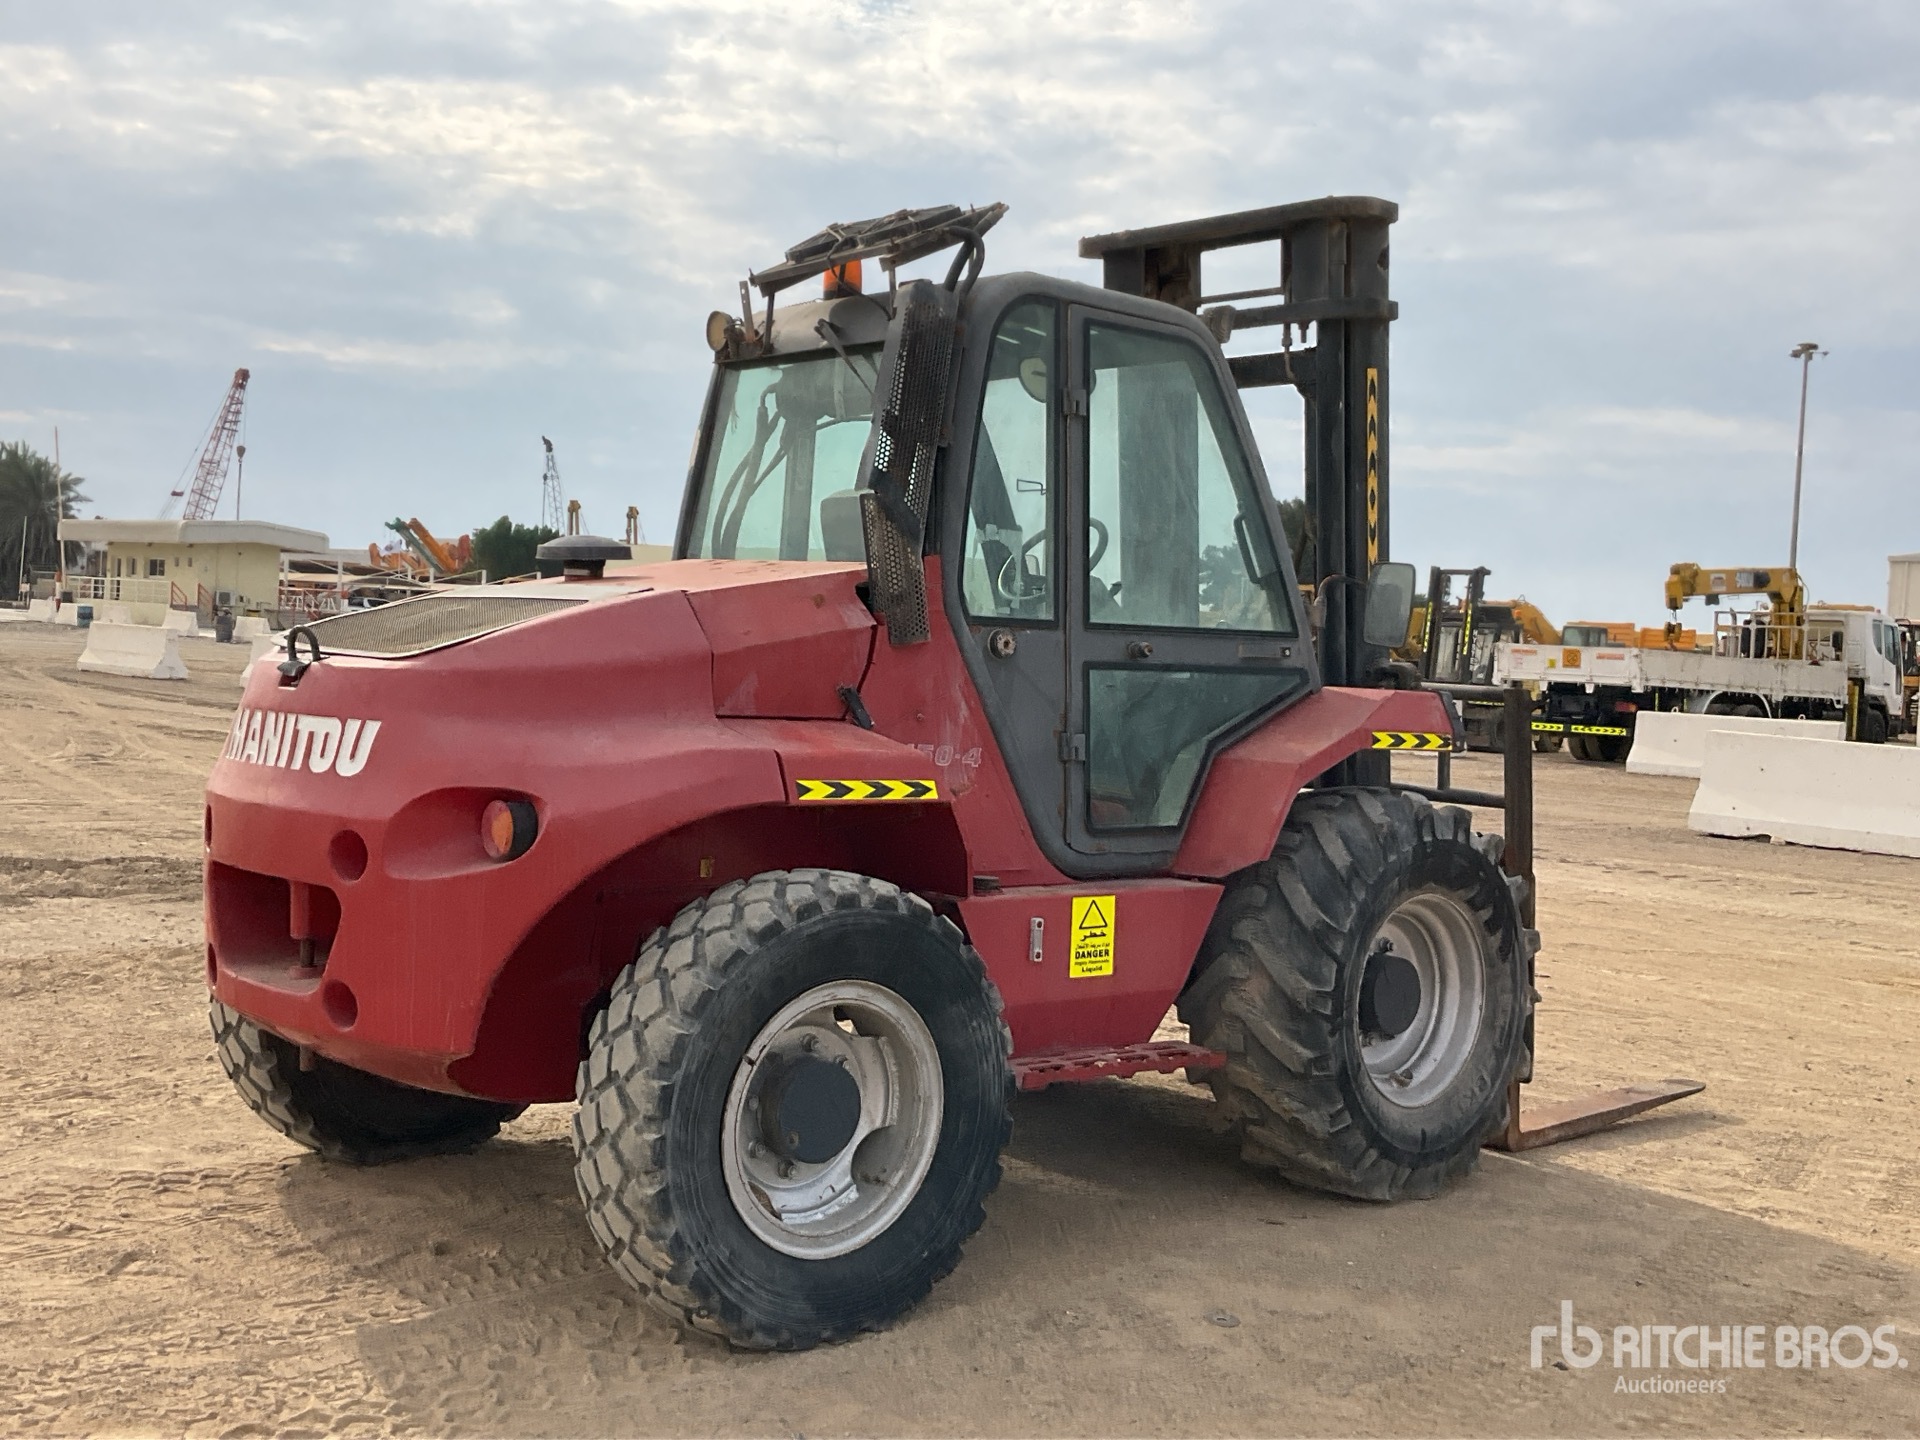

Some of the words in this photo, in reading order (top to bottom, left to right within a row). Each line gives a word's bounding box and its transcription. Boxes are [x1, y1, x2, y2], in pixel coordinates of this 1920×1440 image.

[225, 707, 382, 777] MANITOU
[1080, 930, 1106, 941] خطر
[1075, 949, 1109, 959] DANGER
